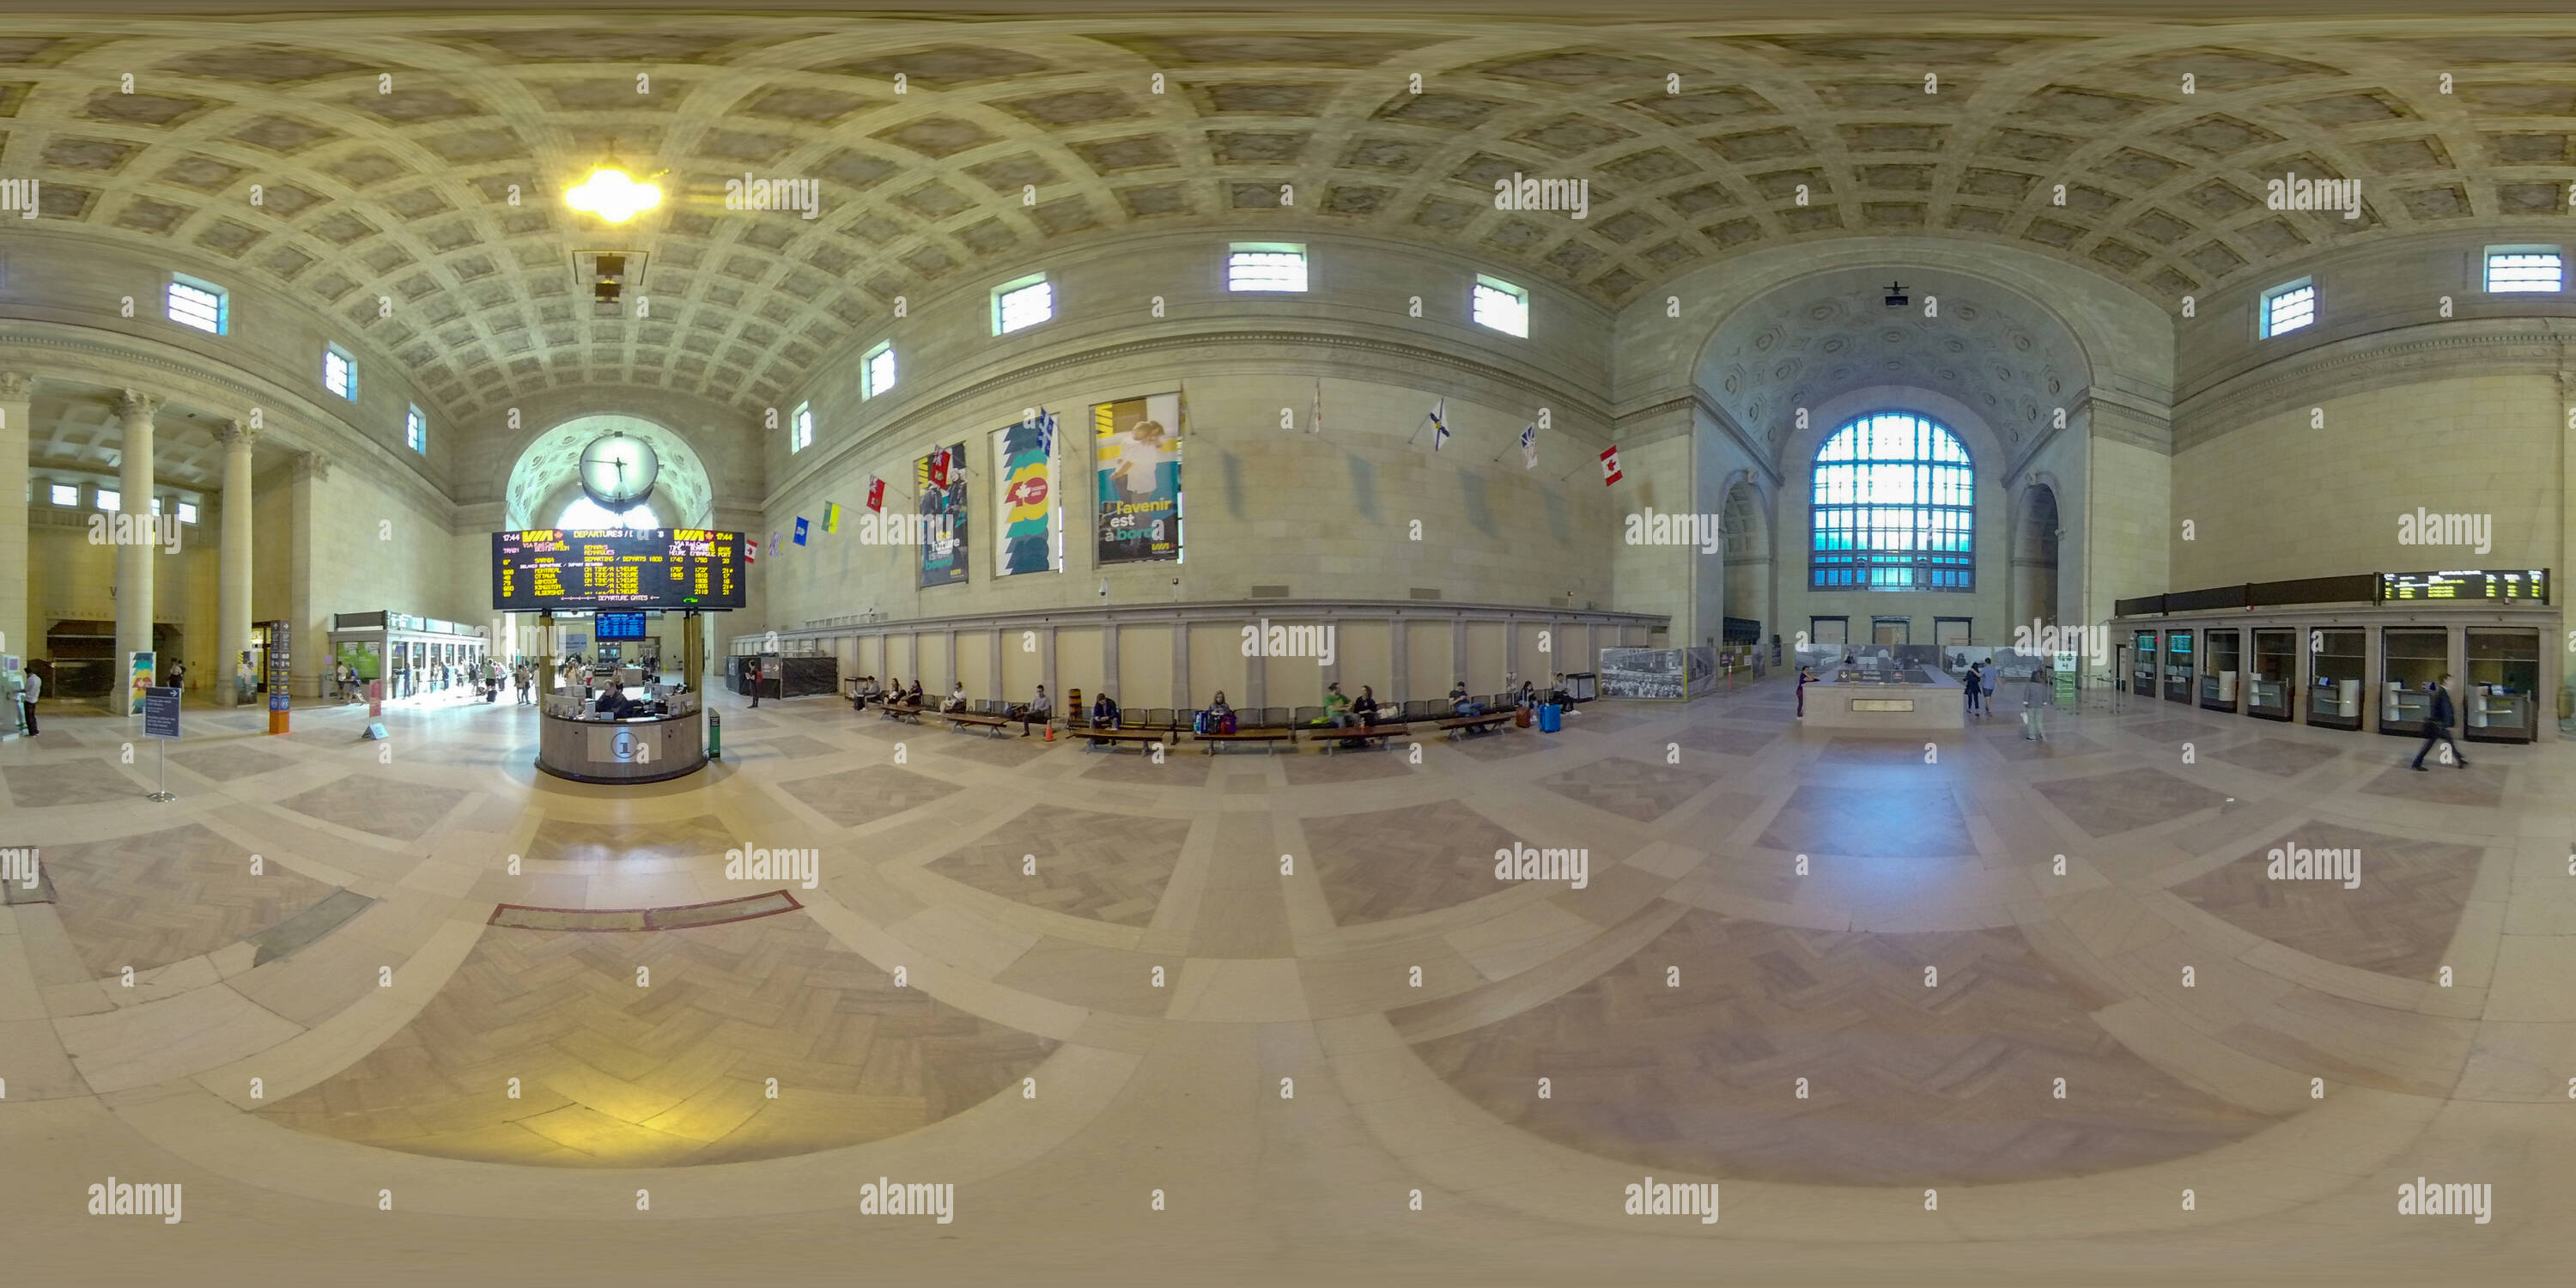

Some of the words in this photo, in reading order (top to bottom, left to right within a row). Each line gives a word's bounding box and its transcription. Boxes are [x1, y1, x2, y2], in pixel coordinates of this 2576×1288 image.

[1116, 498, 1172, 515] l'avenir
[1110, 513, 1135, 528] est
[522, 530, 553, 542] VIA
[574, 530, 623, 538] DEPARTURES
[673, 529, 704, 541] VIA
[1104, 527, 1115, 542] à
[932, 538, 960, 551] future
